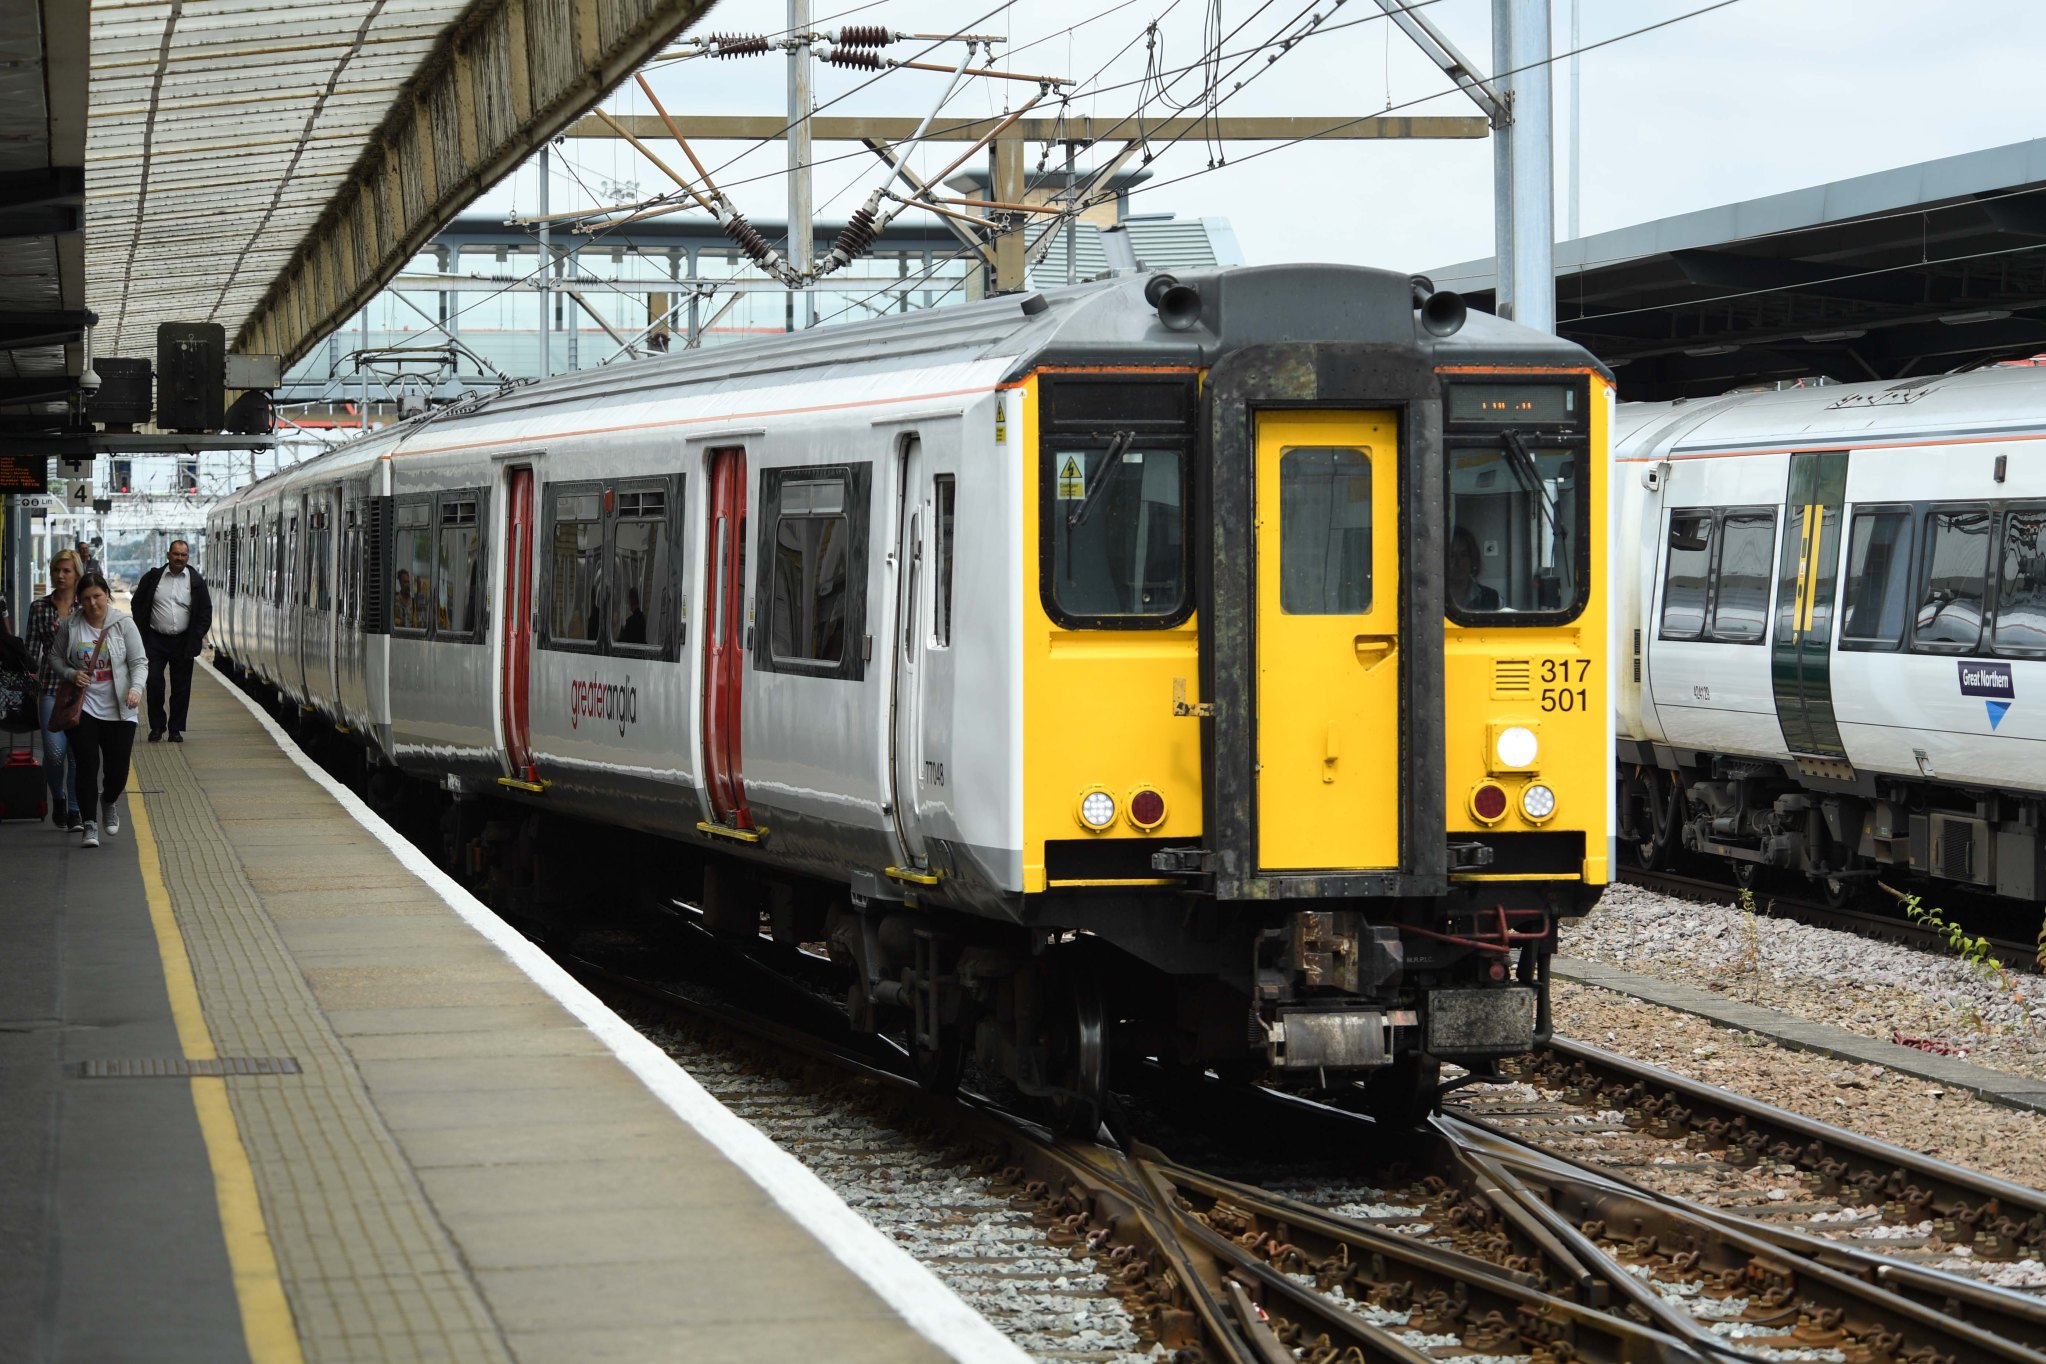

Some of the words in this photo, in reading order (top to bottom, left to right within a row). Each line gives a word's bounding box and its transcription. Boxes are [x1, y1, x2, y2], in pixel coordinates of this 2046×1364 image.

[74, 485, 87, 502] 4
[84, 659, 112, 669] VDA
[1541, 659, 1591, 682] 317
[1963, 668, 1980, 687] Great
[1980, 669, 2009, 688] Northern
[571, 671, 636, 738] greateranglia
[1541, 688, 1586, 712] 501
[926, 761, 944, 787] 77048
